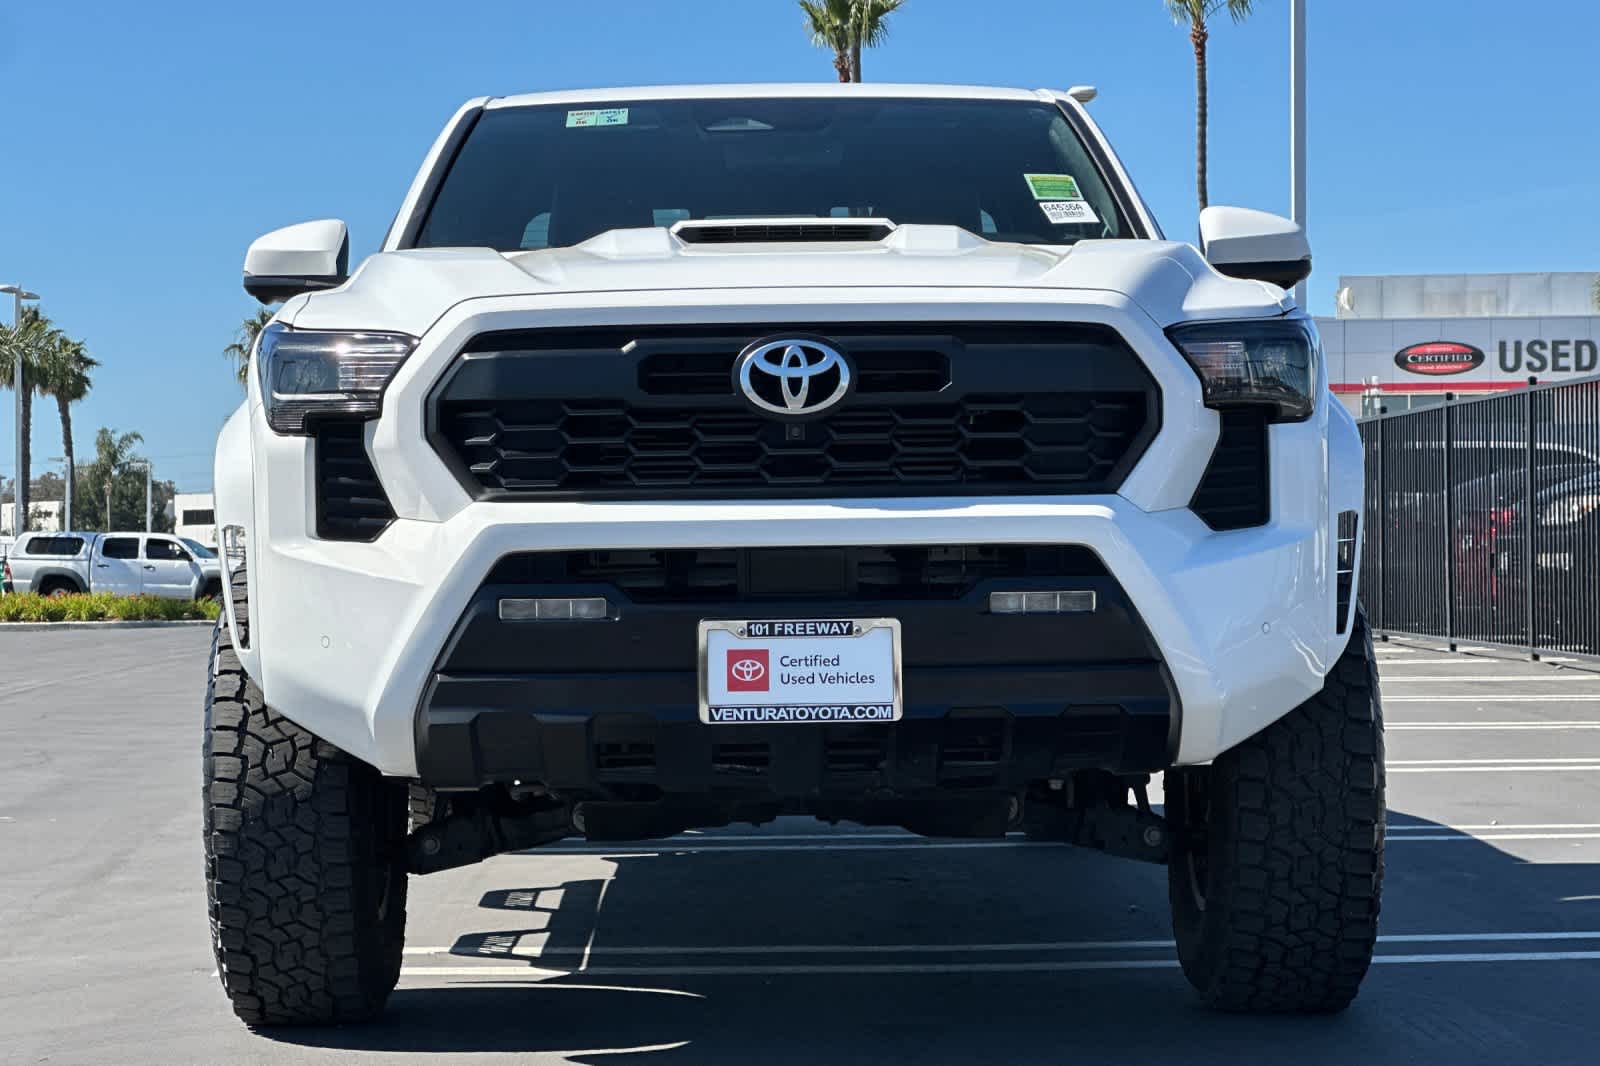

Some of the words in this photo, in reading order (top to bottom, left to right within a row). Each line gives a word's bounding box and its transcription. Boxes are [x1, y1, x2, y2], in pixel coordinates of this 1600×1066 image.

[1407, 354, 1473, 363] CERTIFIED
[1499, 340, 1598, 373] USED
[749, 623, 770, 635] 101
[774, 622, 850, 635] FREEWAY
[780, 655, 840, 667] Certified
[780, 673, 815, 685] Used
[819, 673, 876, 685] Vehicles
[711, 706, 892, 720] VENTURATOYOTA.COM
